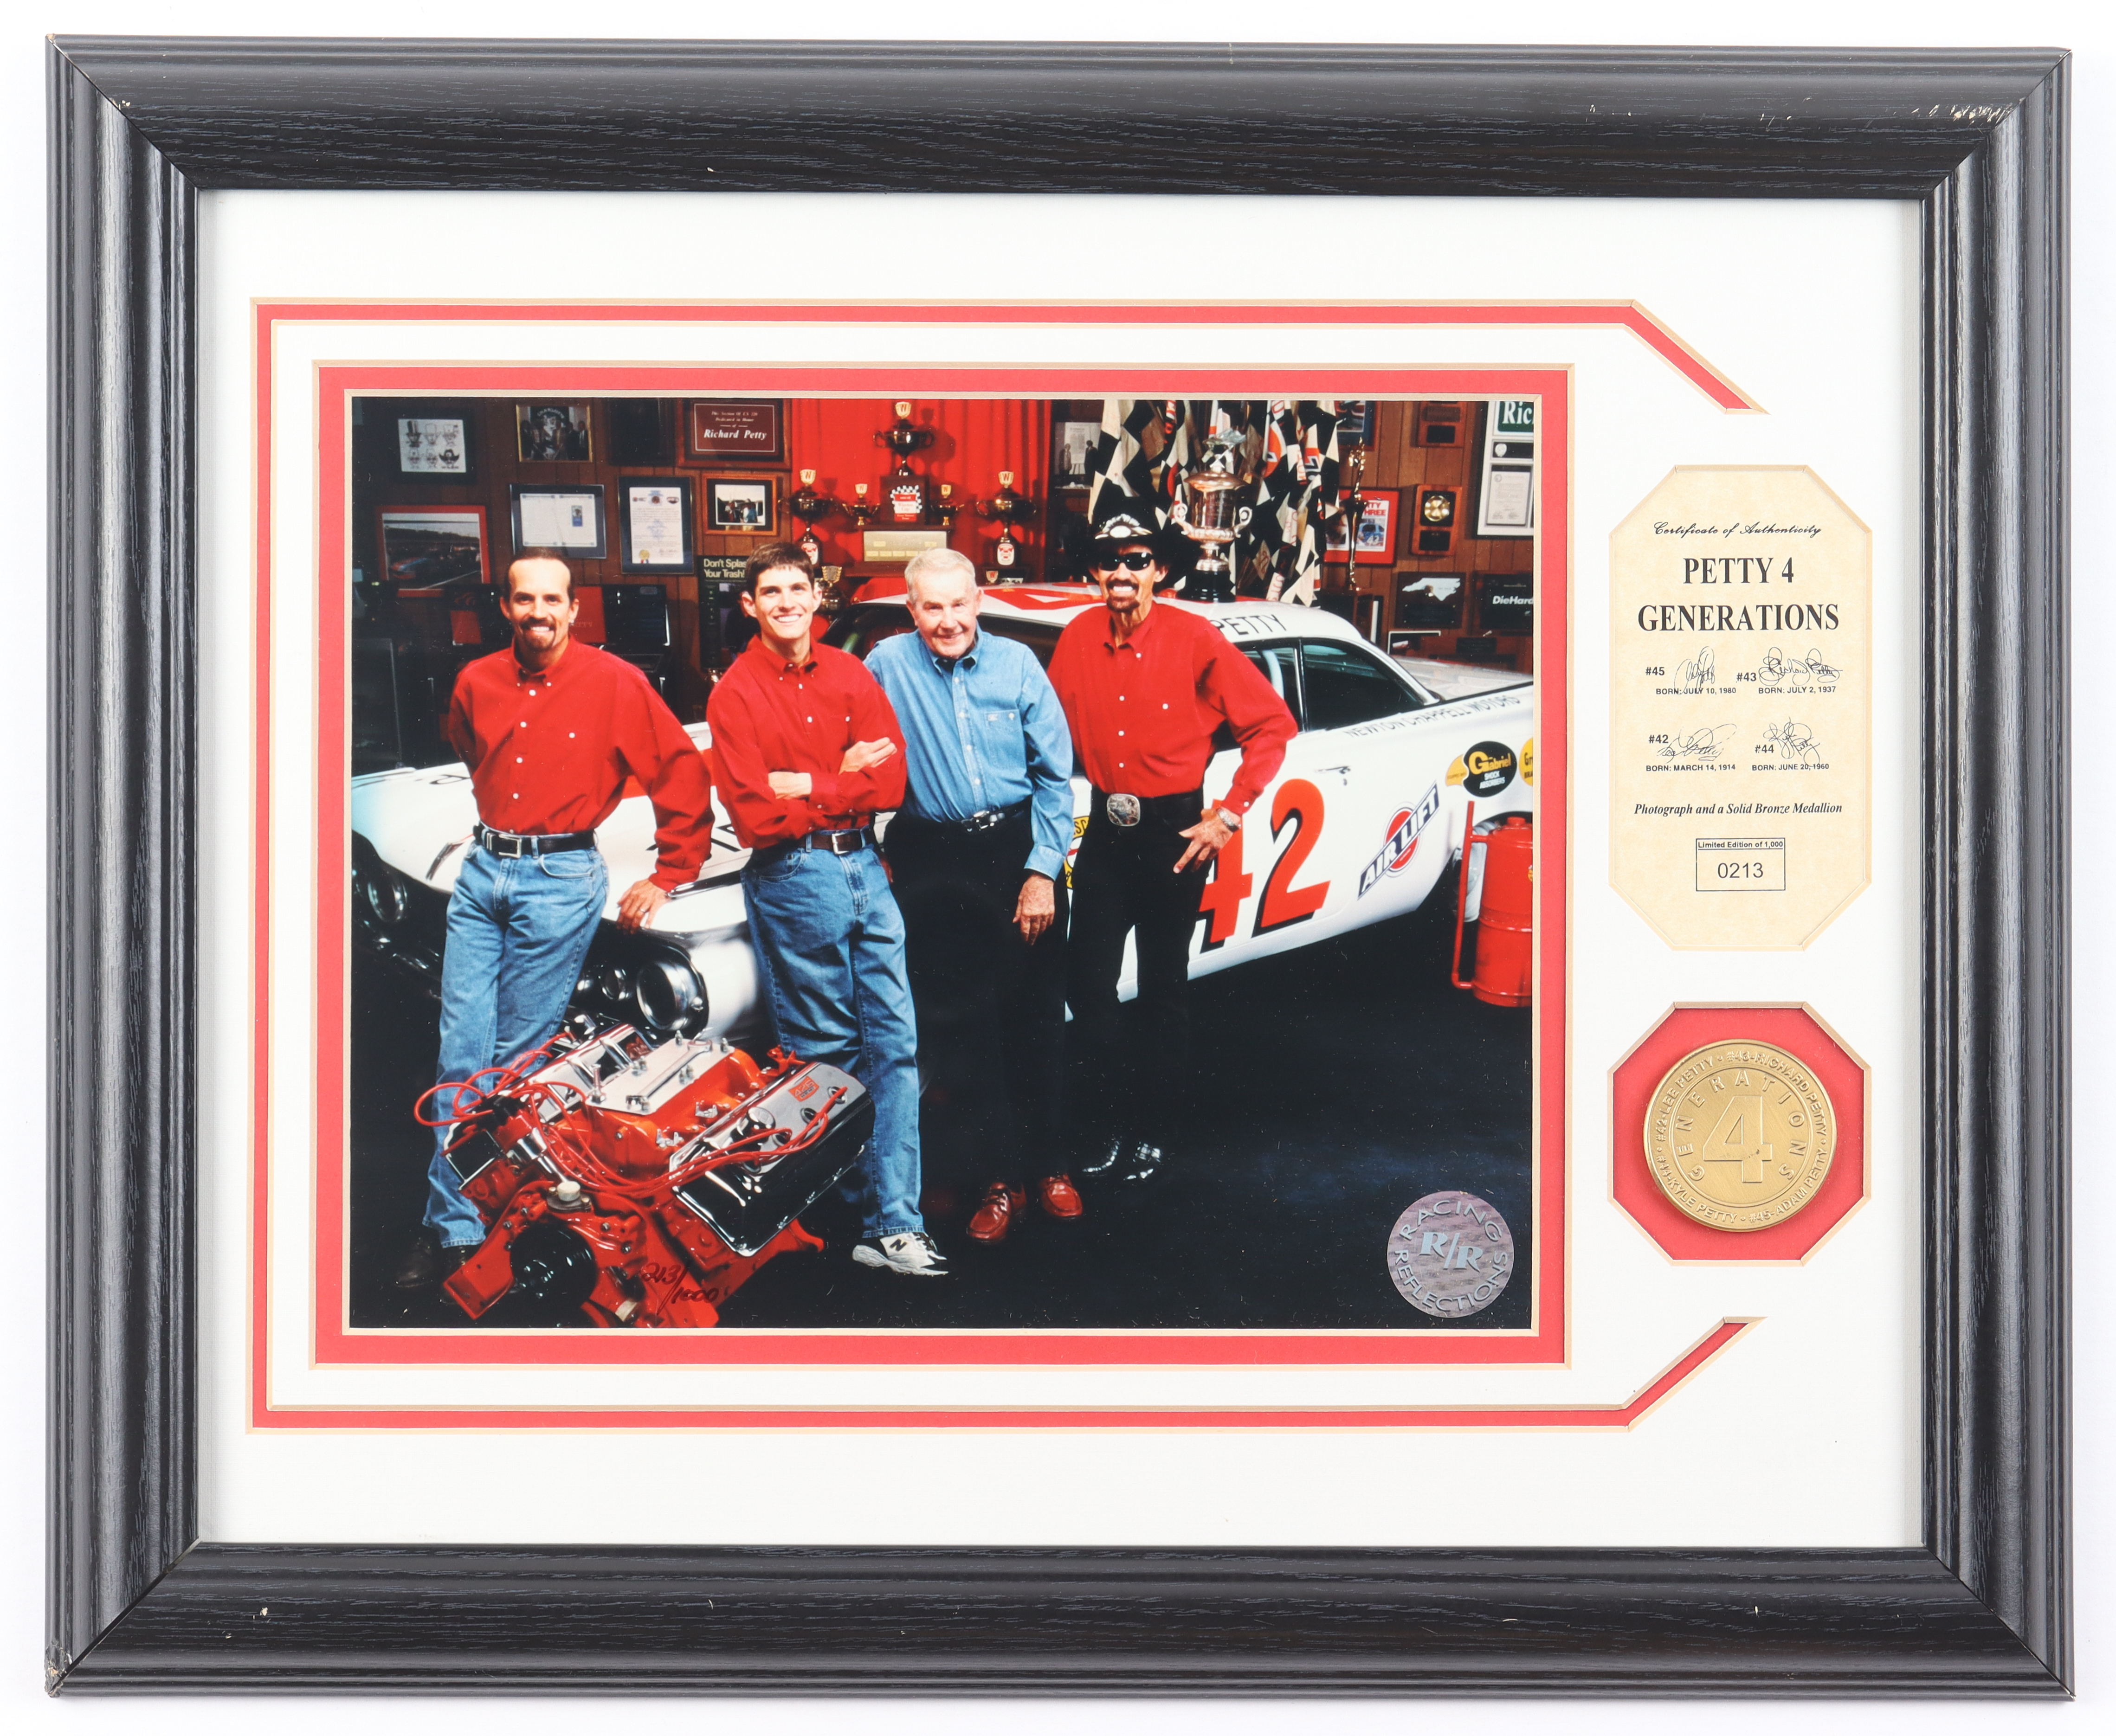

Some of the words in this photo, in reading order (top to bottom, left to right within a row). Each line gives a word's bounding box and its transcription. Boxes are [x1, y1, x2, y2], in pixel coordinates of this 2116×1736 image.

[1502, 401, 1533, 424] Ric
[703, 429, 739, 438] Richard
[744, 430, 767, 440] Petty
[1654, 521, 1718, 539] Certificate
[1723, 522, 1740, 538] of
[1740, 521, 1822, 538] Authenticity
[703, 559, 724, 567] Don't
[725, 559, 747, 570] Splas
[703, 569, 722, 578] Your
[722, 569, 745, 578] Trash!
[1683, 557, 1774, 584] PETTY
[1781, 556, 1794, 583] 4
[1638, 603, 1839, 631] GENERATIONS
[1645, 666, 1665, 675] #45
[1736, 672, 1757, 682] #43
[1344, 720, 1406, 738] NEWTON
[1471, 695, 1521, 712] MOTORS
[1649, 734, 1669, 744] #42
[1755, 744, 1774, 753] #44
[1468, 751, 1511, 775] Gabriel
[1484, 771, 1500, 780] SHOCK
[1634, 803, 1693, 817] Photograph
[1696, 803, 1715, 814] and
[1717, 806, 1724, 815] a
[1726, 803, 1752, 814] Solid
[1755, 803, 1790, 814] Bronze
[1792, 802, 1843, 814] Medallion
[1764, 840, 1784, 849] 1,000
[1199, 778, 1331, 955] 42
[1716, 862, 1764, 879] 0213
[1674, 1055, 1715, 1088] PETTY
[1806, 1092, 1827, 1136] PETTY
[1675, 1070, 1807, 1182] GENERATIONS
[1703, 1094, 1773, 1183] 4
[1805, 1146, 1828, 1189] PETTY
[1399, 1199, 1503, 1242] RACING
[1695, 1203, 1738, 1223] PETTY
[889, 1238, 908, 1252] N
[1419, 1232, 1484, 1273] R/R
[1394, 1249, 1508, 1312] REFLECTIONS
